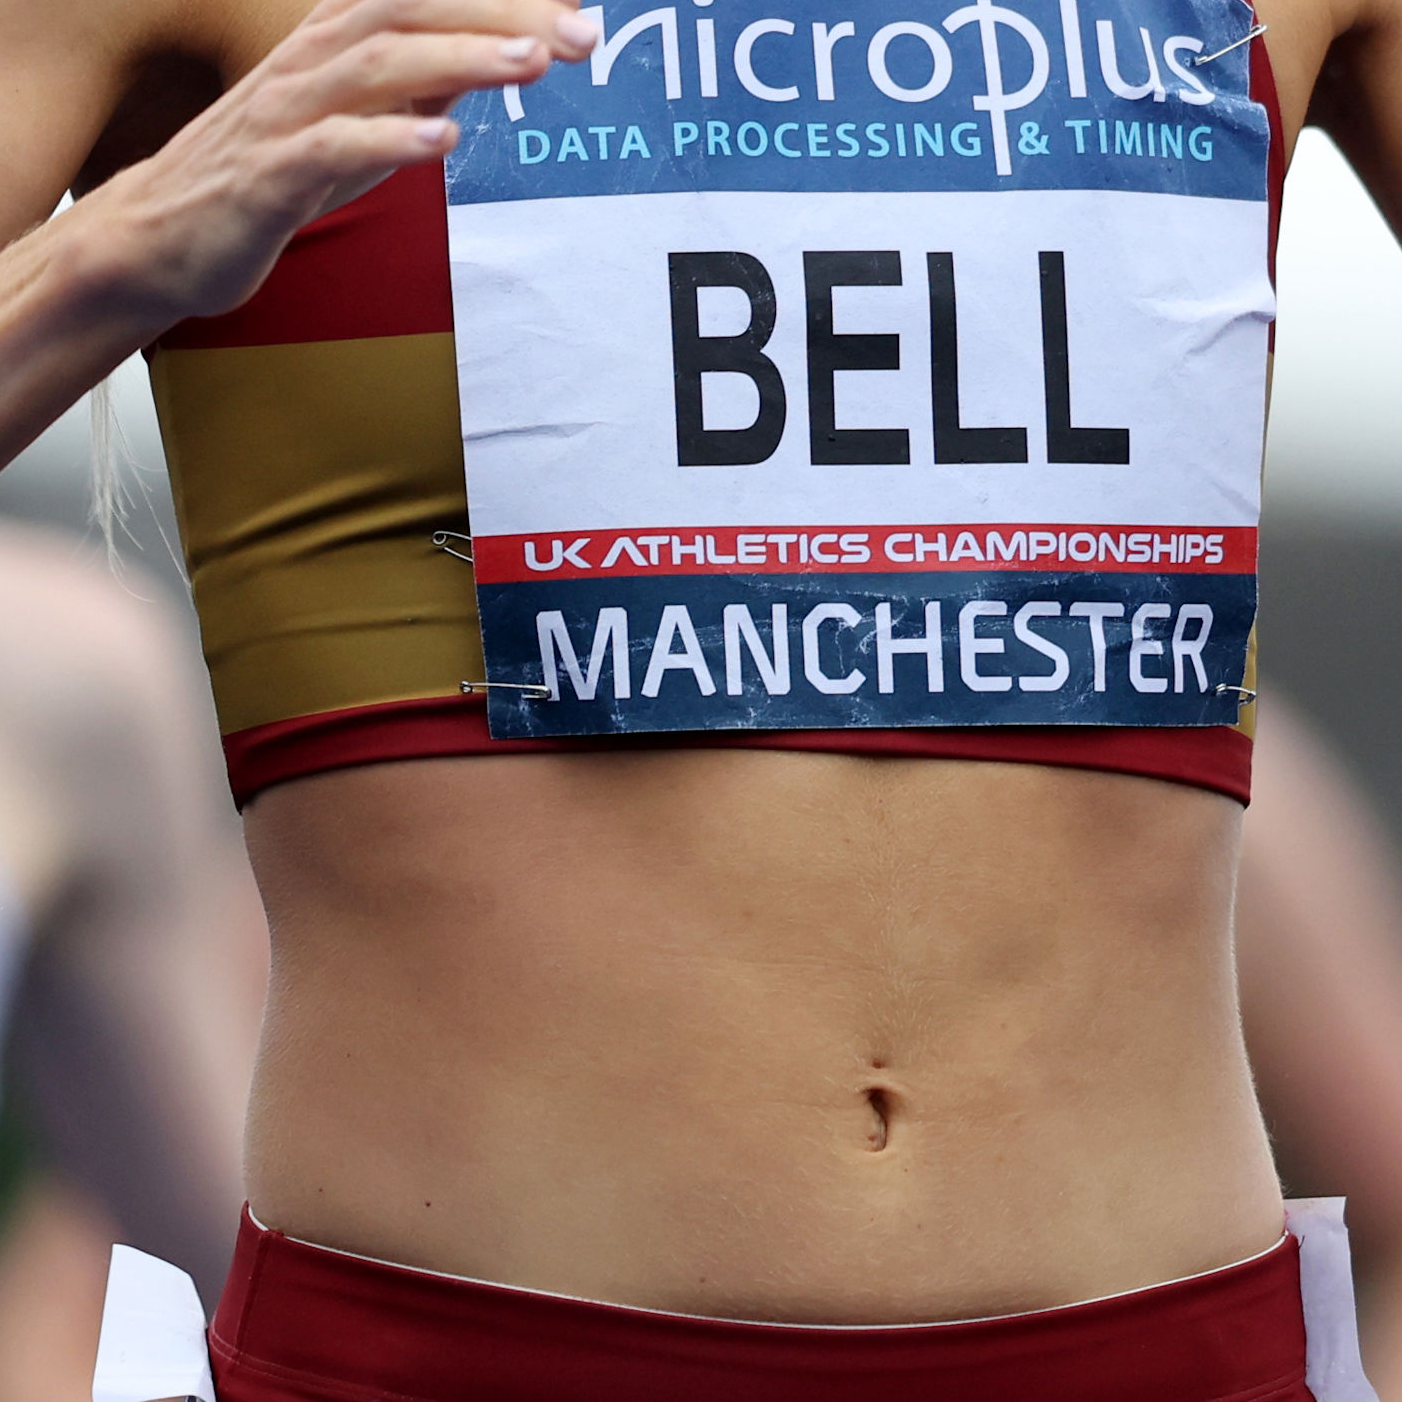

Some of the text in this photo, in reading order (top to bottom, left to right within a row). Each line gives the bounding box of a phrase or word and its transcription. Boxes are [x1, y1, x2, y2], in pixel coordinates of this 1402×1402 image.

[517, 119, 1215, 165] DATA PROCESSING & TIMING
[667, 250, 1131, 467] BELL
[524, 530, 1225, 572] UK ATHLETICS CHAMPIONSHIPS
[535, 600, 1215, 702] MANCHESTER
